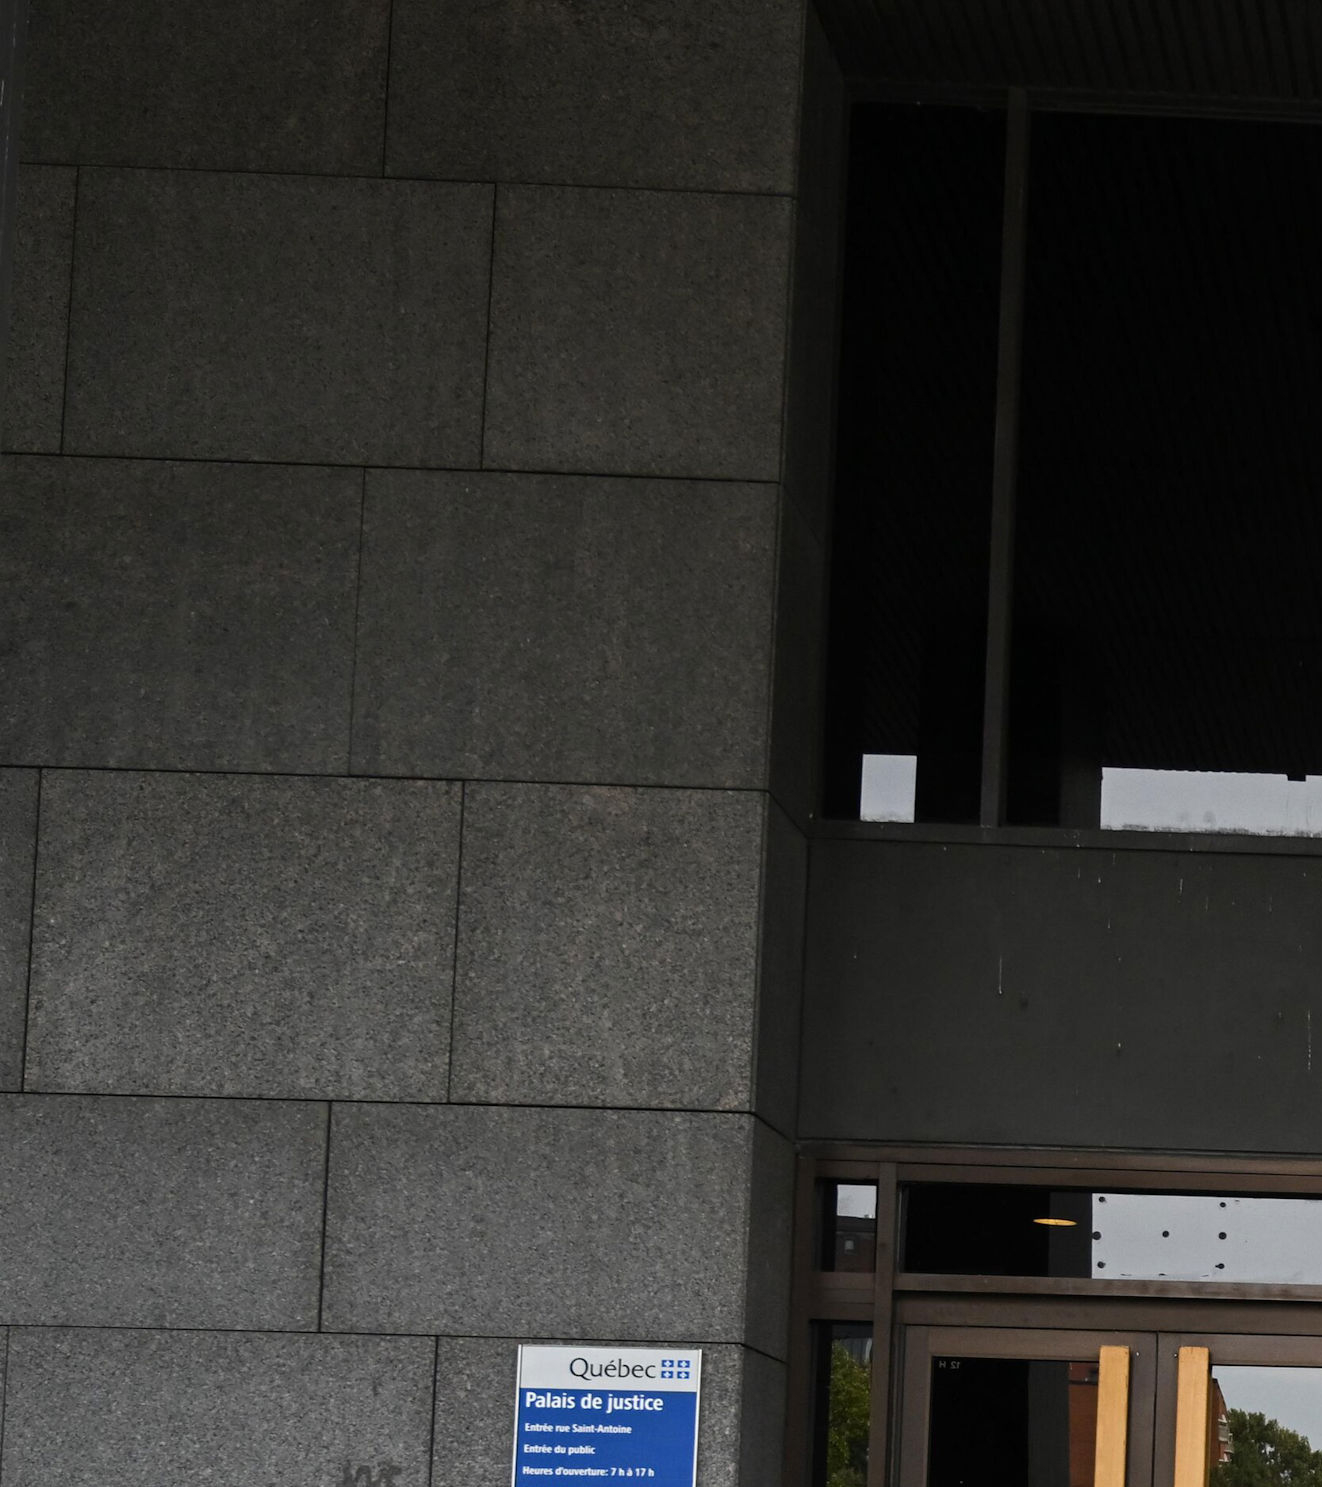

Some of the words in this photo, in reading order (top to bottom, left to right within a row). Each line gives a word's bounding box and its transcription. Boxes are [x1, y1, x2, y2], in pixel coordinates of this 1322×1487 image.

[569, 1358, 656, 1380] Québec
[526, 1392, 575, 1408] Palais
[581, 1394, 602, 1409] de
[607, 1394, 663, 1413] justice
[525, 1423, 553, 1432] Entrée
[572, 1424, 632, 1433] Saint-Antoine
[524, 1444, 552, 1453] Entrée
[554, 1445, 566, 1453] du
[568, 1446, 595, 1455] public
[523, 1466, 553, 1475] Heures
[611, 1468, 616, 1476] 7
[626, 1468, 633, 1476] à
[635, 1468, 646, 1476] 17
[648, 1468, 654, 1476] h
